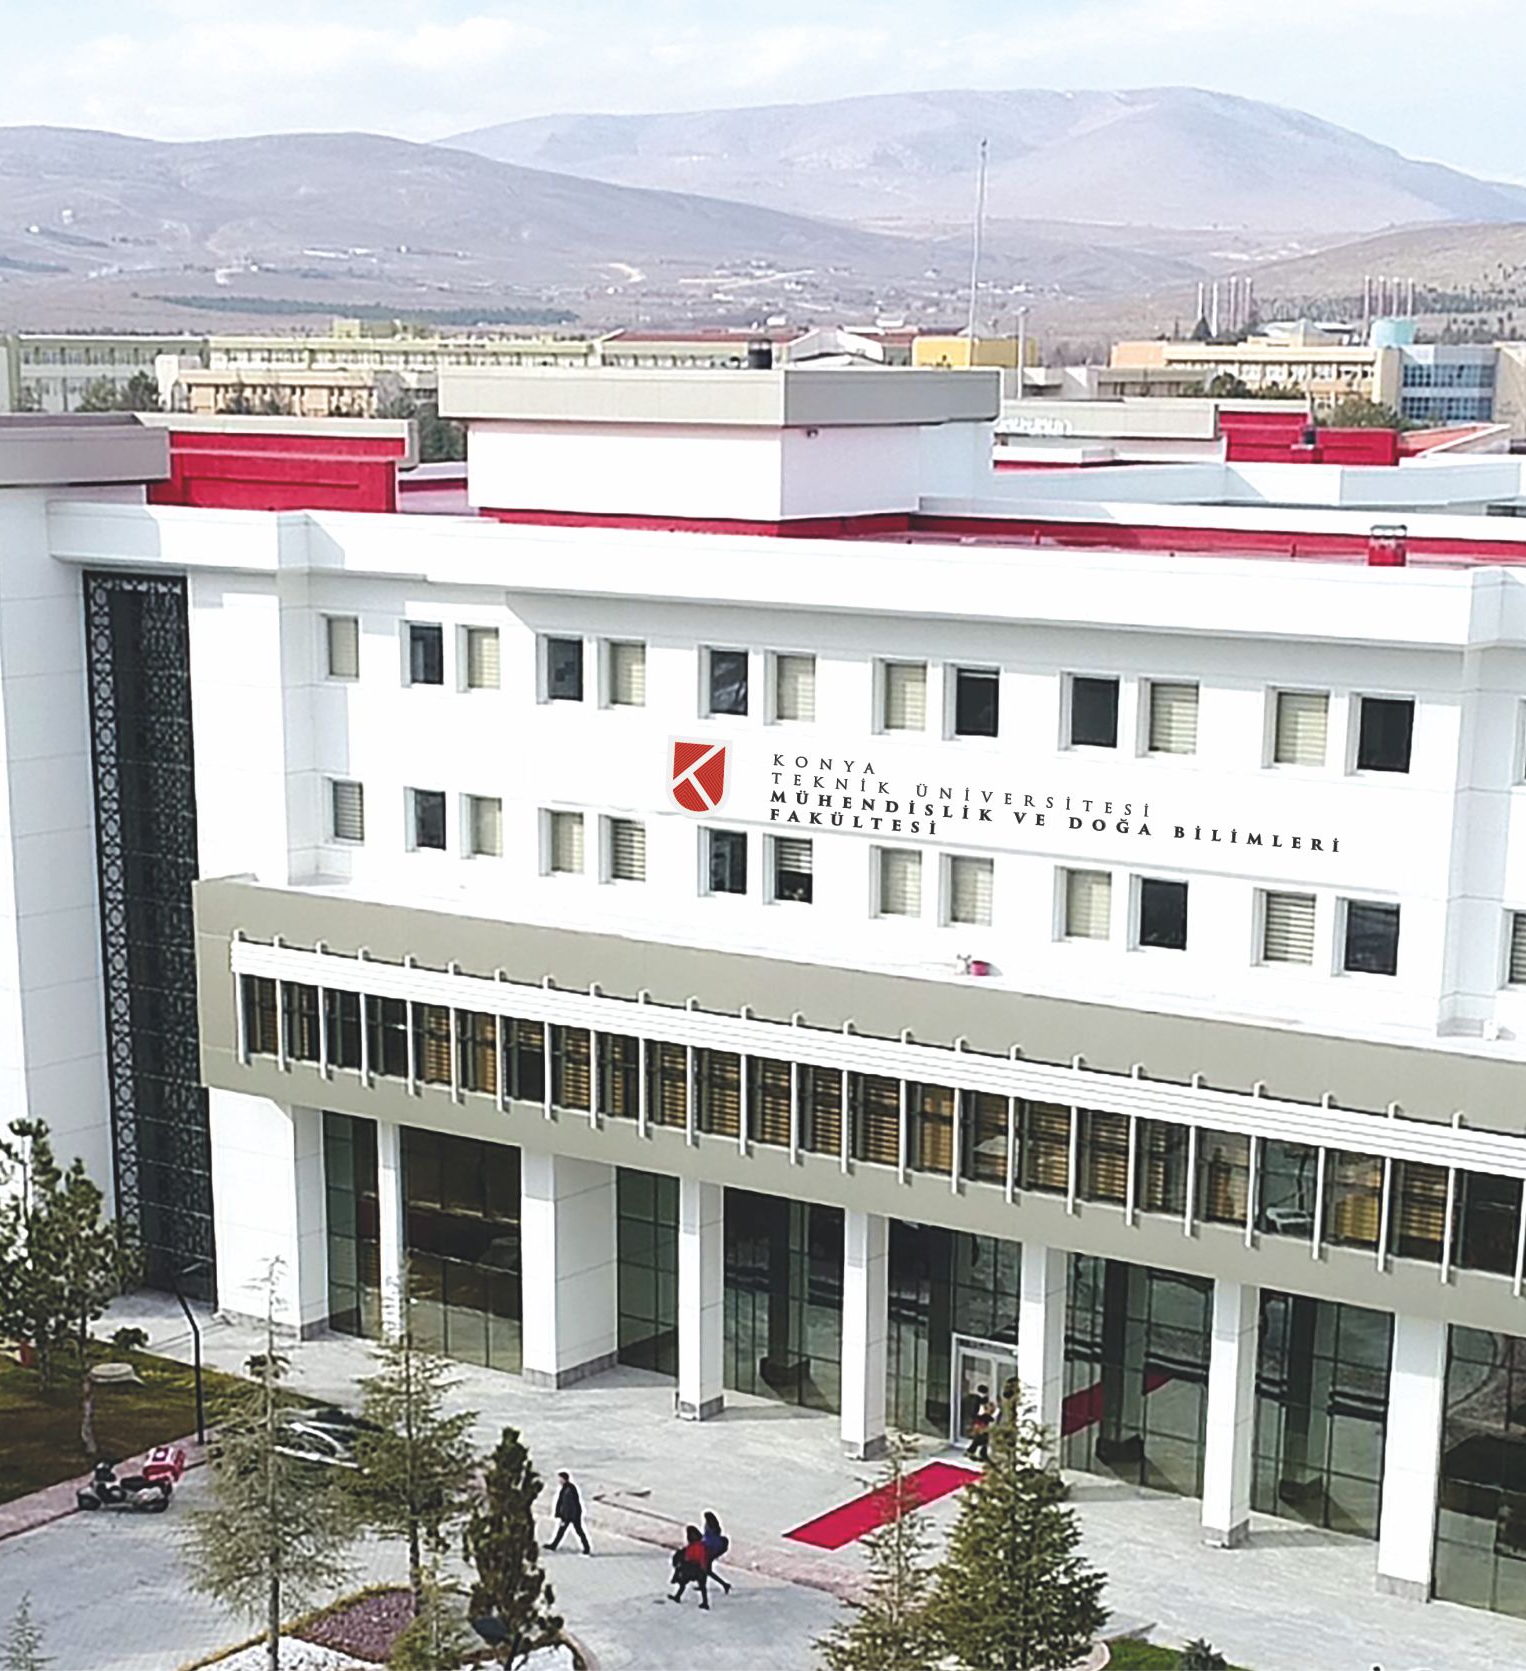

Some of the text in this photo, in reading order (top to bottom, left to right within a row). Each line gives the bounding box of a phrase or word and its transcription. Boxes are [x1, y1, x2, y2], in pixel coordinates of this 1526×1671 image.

[773, 753, 875, 775] KONYA
[772, 772, 1149, 818] TEKNİK ÜNİVERSİTESİ
[770, 790, 1340, 853] MÜHENDİSLİK VE DOĞA BİLİMLERİ
[770, 808, 936, 835] FAKÜLTESİ
